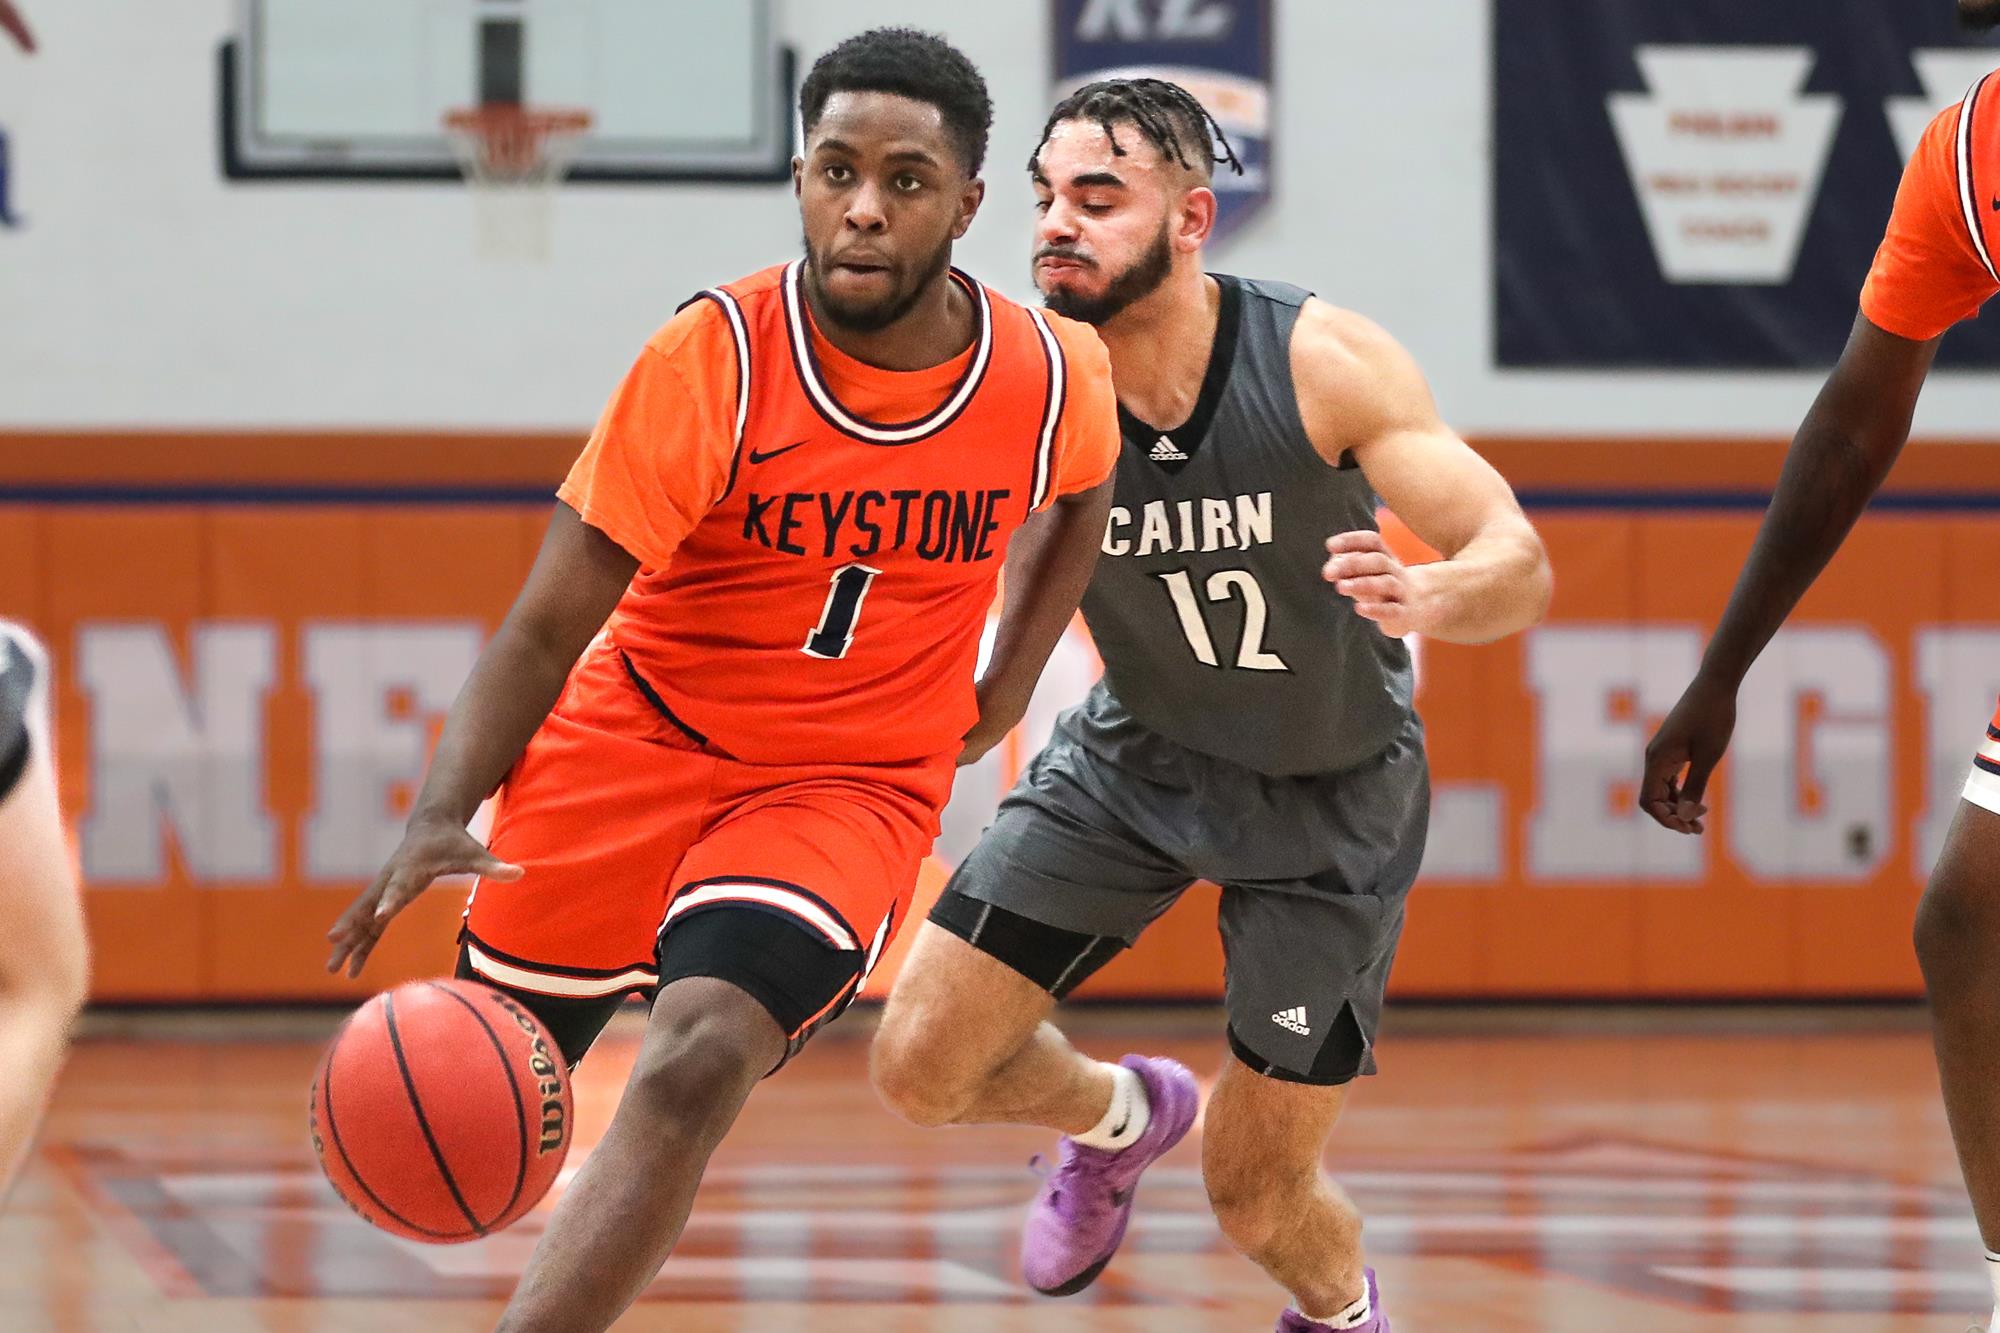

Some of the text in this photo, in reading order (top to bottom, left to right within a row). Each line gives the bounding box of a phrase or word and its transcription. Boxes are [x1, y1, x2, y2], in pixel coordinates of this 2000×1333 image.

[742, 489, 1010, 563] KEYSTONE
[1101, 492, 1273, 557] CAIRN
[799, 562, 884, 659] 1
[1156, 569, 1290, 671] 12
[1271, 1014, 1310, 1035] adidas
